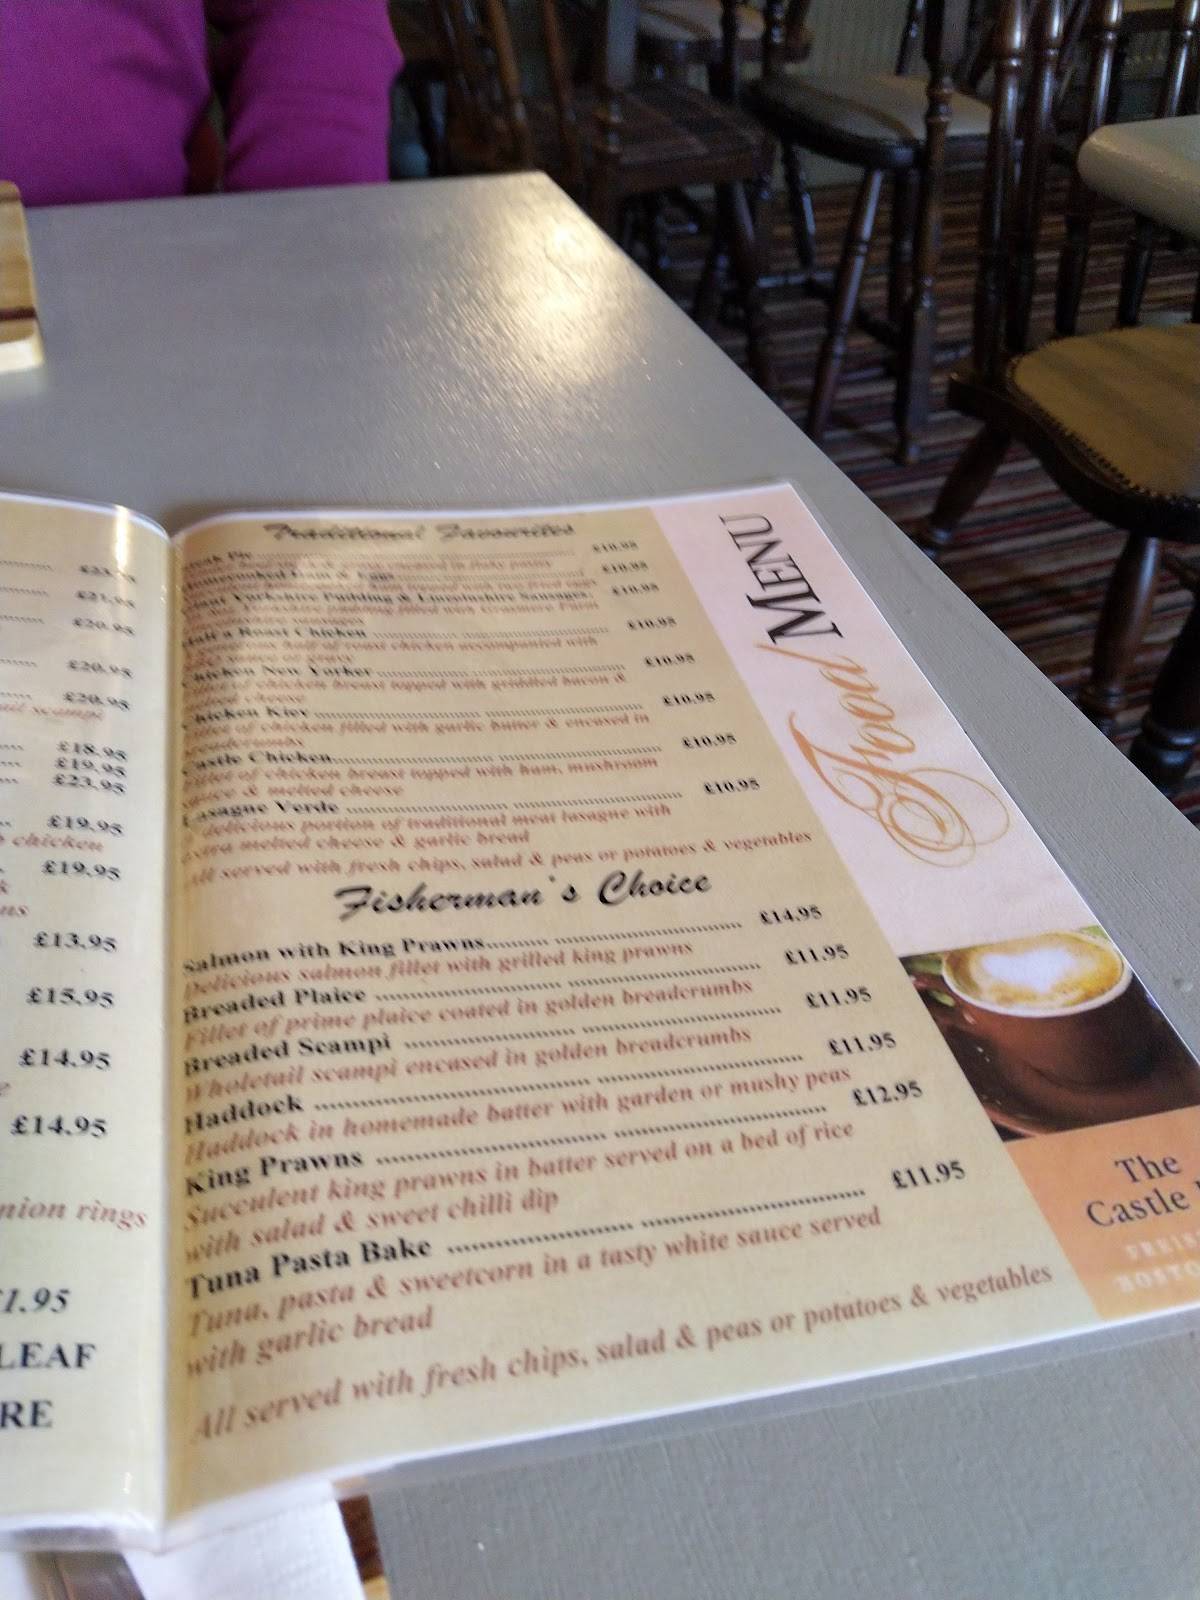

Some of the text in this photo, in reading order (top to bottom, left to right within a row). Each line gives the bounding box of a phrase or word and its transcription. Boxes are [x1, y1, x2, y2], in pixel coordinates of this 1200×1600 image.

[436, 523, 575, 541] Favourites
[612, 582, 660, 597] £10.95
[295, 626, 367, 640] Chicken
[627, 615, 678, 632] £10.95
[308, 664, 370, 678] Yorker
[643, 652, 696, 670] £10.95
[266, 690, 716, 719] Kiev £10.95
[55, 757, 127, 778] £19.95
[248, 732, 737, 765] Chicken £10.95
[754, 641, 1011, 868] Food
[274, 777, 761, 814] Verde £10.95
[12, 833, 104, 852] chicken
[48, 814, 125, 836] £19.95
[529, 849, 545, 867] &
[551, 850, 593, 868] peas
[598, 848, 618, 862] or
[623, 842, 698, 861] potatoes
[722, 829, 813, 852] vegetables
[42, 859, 122, 881] £19.95
[598, 868, 713, 907] Choice
[33, 931, 118, 952] £13.95
[184, 903, 823, 976] Salmon with King Prawns £14.95
[299, 962, 382, 982] salmon
[387, 958, 443, 982] fillet
[446, 953, 492, 974] with
[498, 949, 566, 974] grilled
[572, 946, 617, 967] king
[622, 942, 693, 964] prawns
[26, 986, 115, 1008] £15.95
[184, 943, 850, 1024] Breaded Plaice £11.95
[253, 1013, 283, 1037] of
[285, 1011, 357, 1036] prime
[362, 1006, 433, 1031] plaice
[438, 999, 511, 1024] coated
[517, 997, 539, 1015] in
[544, 992, 616, 1018] golden
[622, 979, 754, 1006] breadcrumbs
[184, 986, 873, 1078] Breaded Scampi £11.95
[18, 1048, 111, 1071] £14.95
[312, 1058, 398, 1083] scampi
[405, 1049, 498, 1076] encased
[505, 1047, 528, 1067] in
[534, 1040, 608, 1067] golden
[615, 1025, 752, 1056] breadcrumbs
[184, 1030, 898, 1136] Haddock £11.95
[308, 1119, 335, 1141] in
[342, 1106, 479, 1139] homemade
[486, 1101, 554, 1125] batter
[561, 1092, 609, 1115] with
[616, 1083, 694, 1114] garden
[699, 1081, 723, 1100] or
[730, 1070, 801, 1098] mushy
[805, 1067, 853, 1092] peas
[10, 1115, 109, 1139] £14.95
[185, 1079, 924, 1198] King Prawns £12.95
[186, 1120, 854, 1231] Succulent king prawns in batter served on a bed of rice
[1114, 1153, 1183, 1184] The
[0, 1195, 148, 1232] nion rings
[186, 1186, 559, 1264] with salad & sweet chilli dip
[1086, 1187, 1191, 1228] Castle
[186, 1159, 966, 1300] Tuna Pasta Bake £11.95
[188, 1204, 882, 1338] Tuna, pasta & sweetcorn in a tasty white sauce served
[0, 1286, 71, 1315] 1.95
[188, 1302, 434, 1377] with garlic bread
[243, 1376, 345, 1428] served
[351, 1367, 415, 1401] with
[421, 1355, 497, 1400] fresh
[506, 1345, 590, 1379] chips,
[596, 1327, 667, 1364] salad
[675, 1322, 697, 1351] &
[705, 1316, 763, 1351] peas
[770, 1309, 796, 1334] or
[803, 1291, 903, 1335] potatoes
[910, 1283, 931, 1309] &
[936, 1262, 1053, 1304] vegetables
